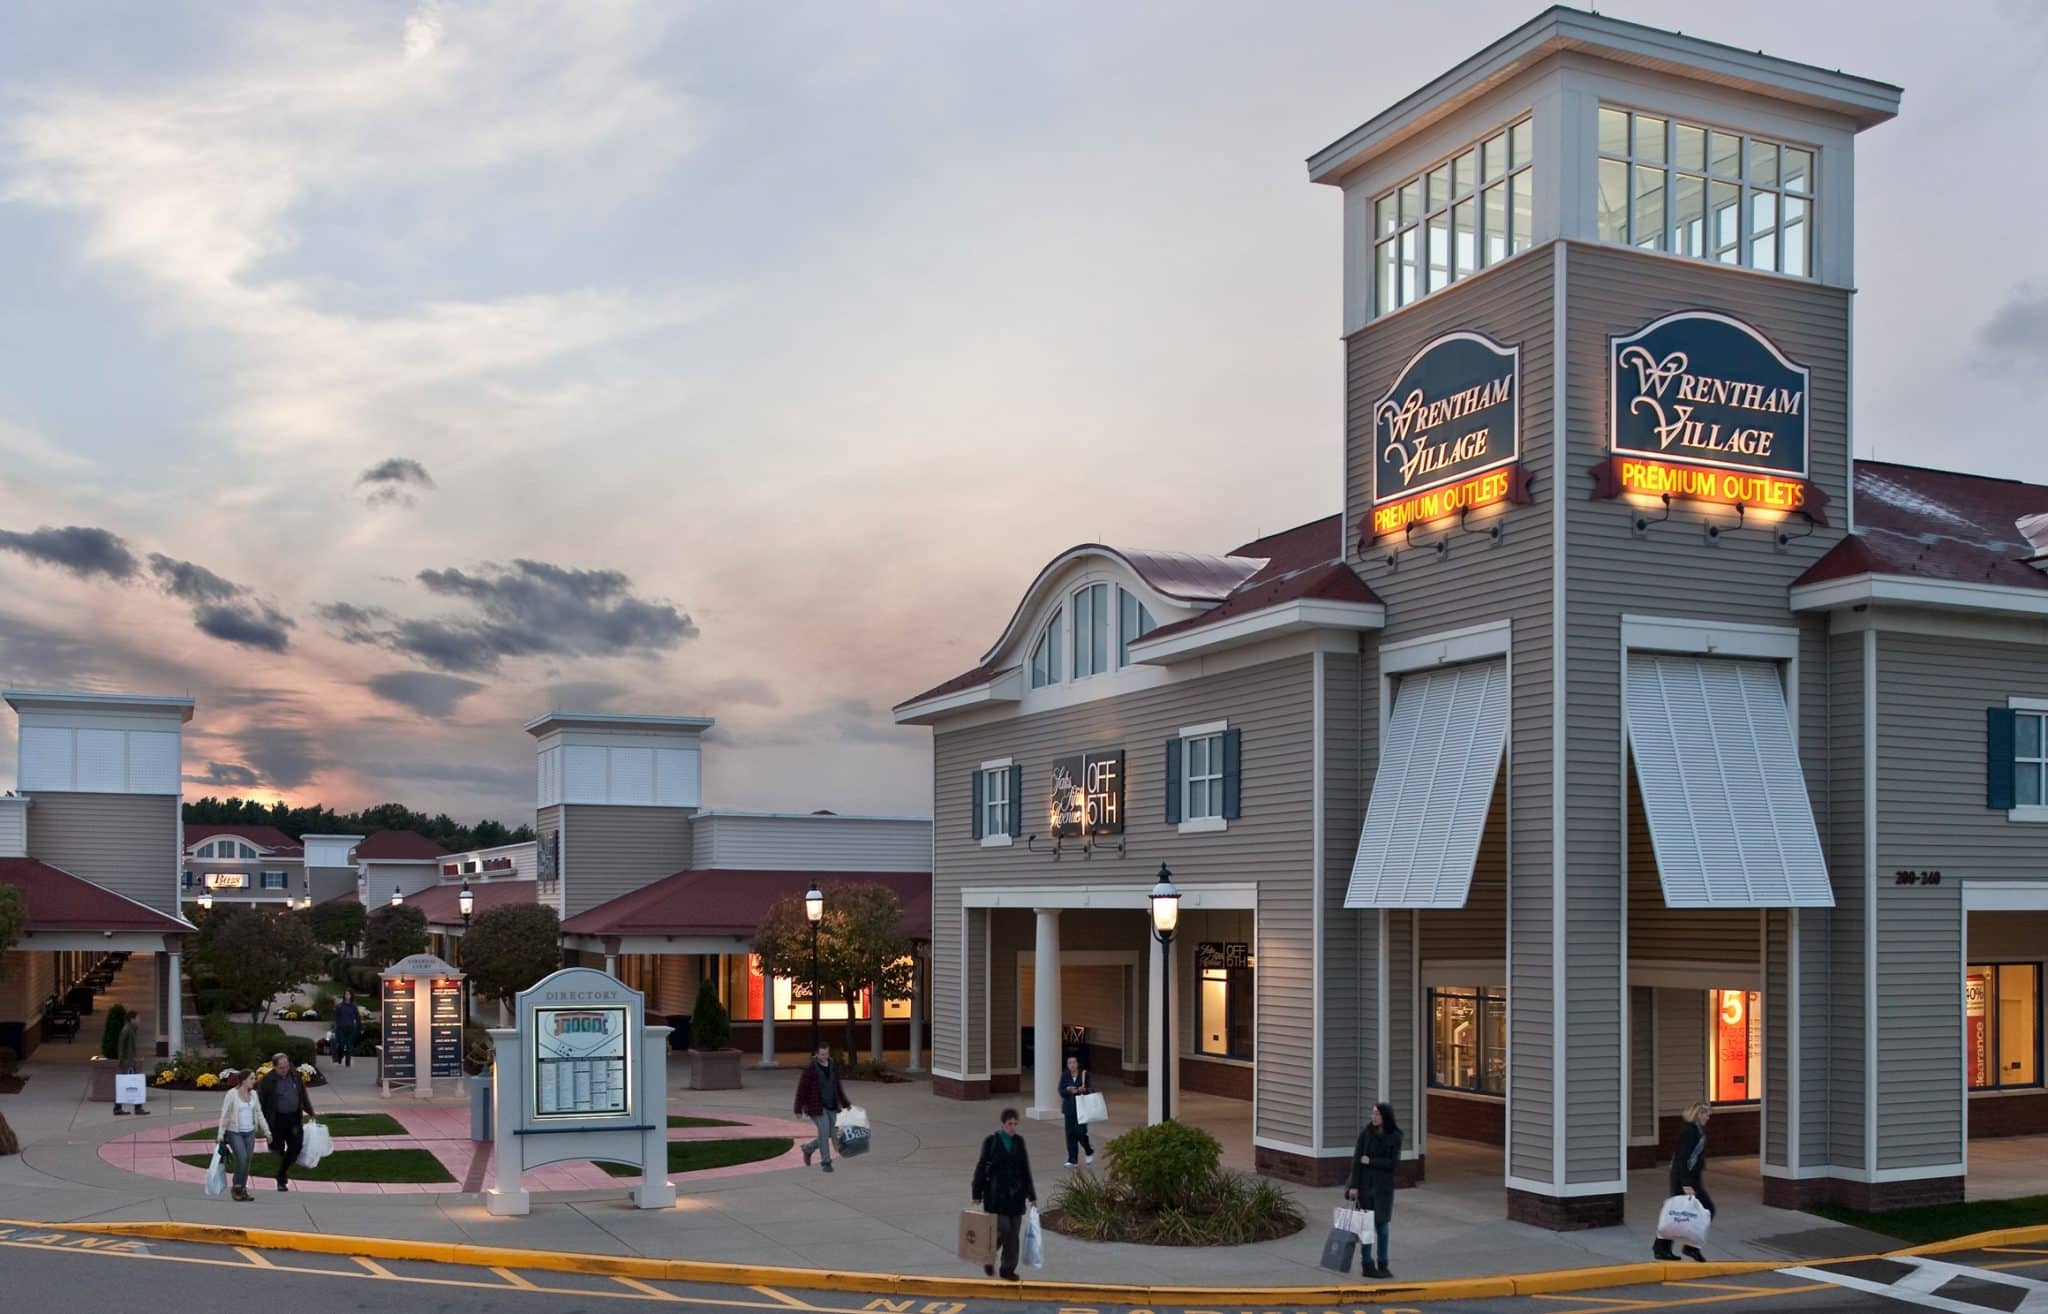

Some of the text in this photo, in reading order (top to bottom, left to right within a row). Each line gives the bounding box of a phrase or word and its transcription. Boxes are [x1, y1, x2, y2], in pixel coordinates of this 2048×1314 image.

[1619, 346, 1803, 415] WRENTHAM
[1377, 374, 1513, 443] WRENTHAM
[1631, 396, 1775, 456] VILLAGE
[1384, 428, 1489, 486] VILLAGE
[1374, 471, 1509, 532] PREMIUM OUTLETS
[1622, 463, 1806, 507] PREMIUM OUTLETS
[1087, 760, 1116, 794] OFF
[1087, 791, 1116, 825] 5TH
[1226, 944, 1246, 957] OFF
[546, 991, 617, 1000] DIRECTORY
[1722, 990, 1743, 1025] 5
[1976, 1022, 1984, 1087] learance
[862, 1298, 967, 1314] NO
